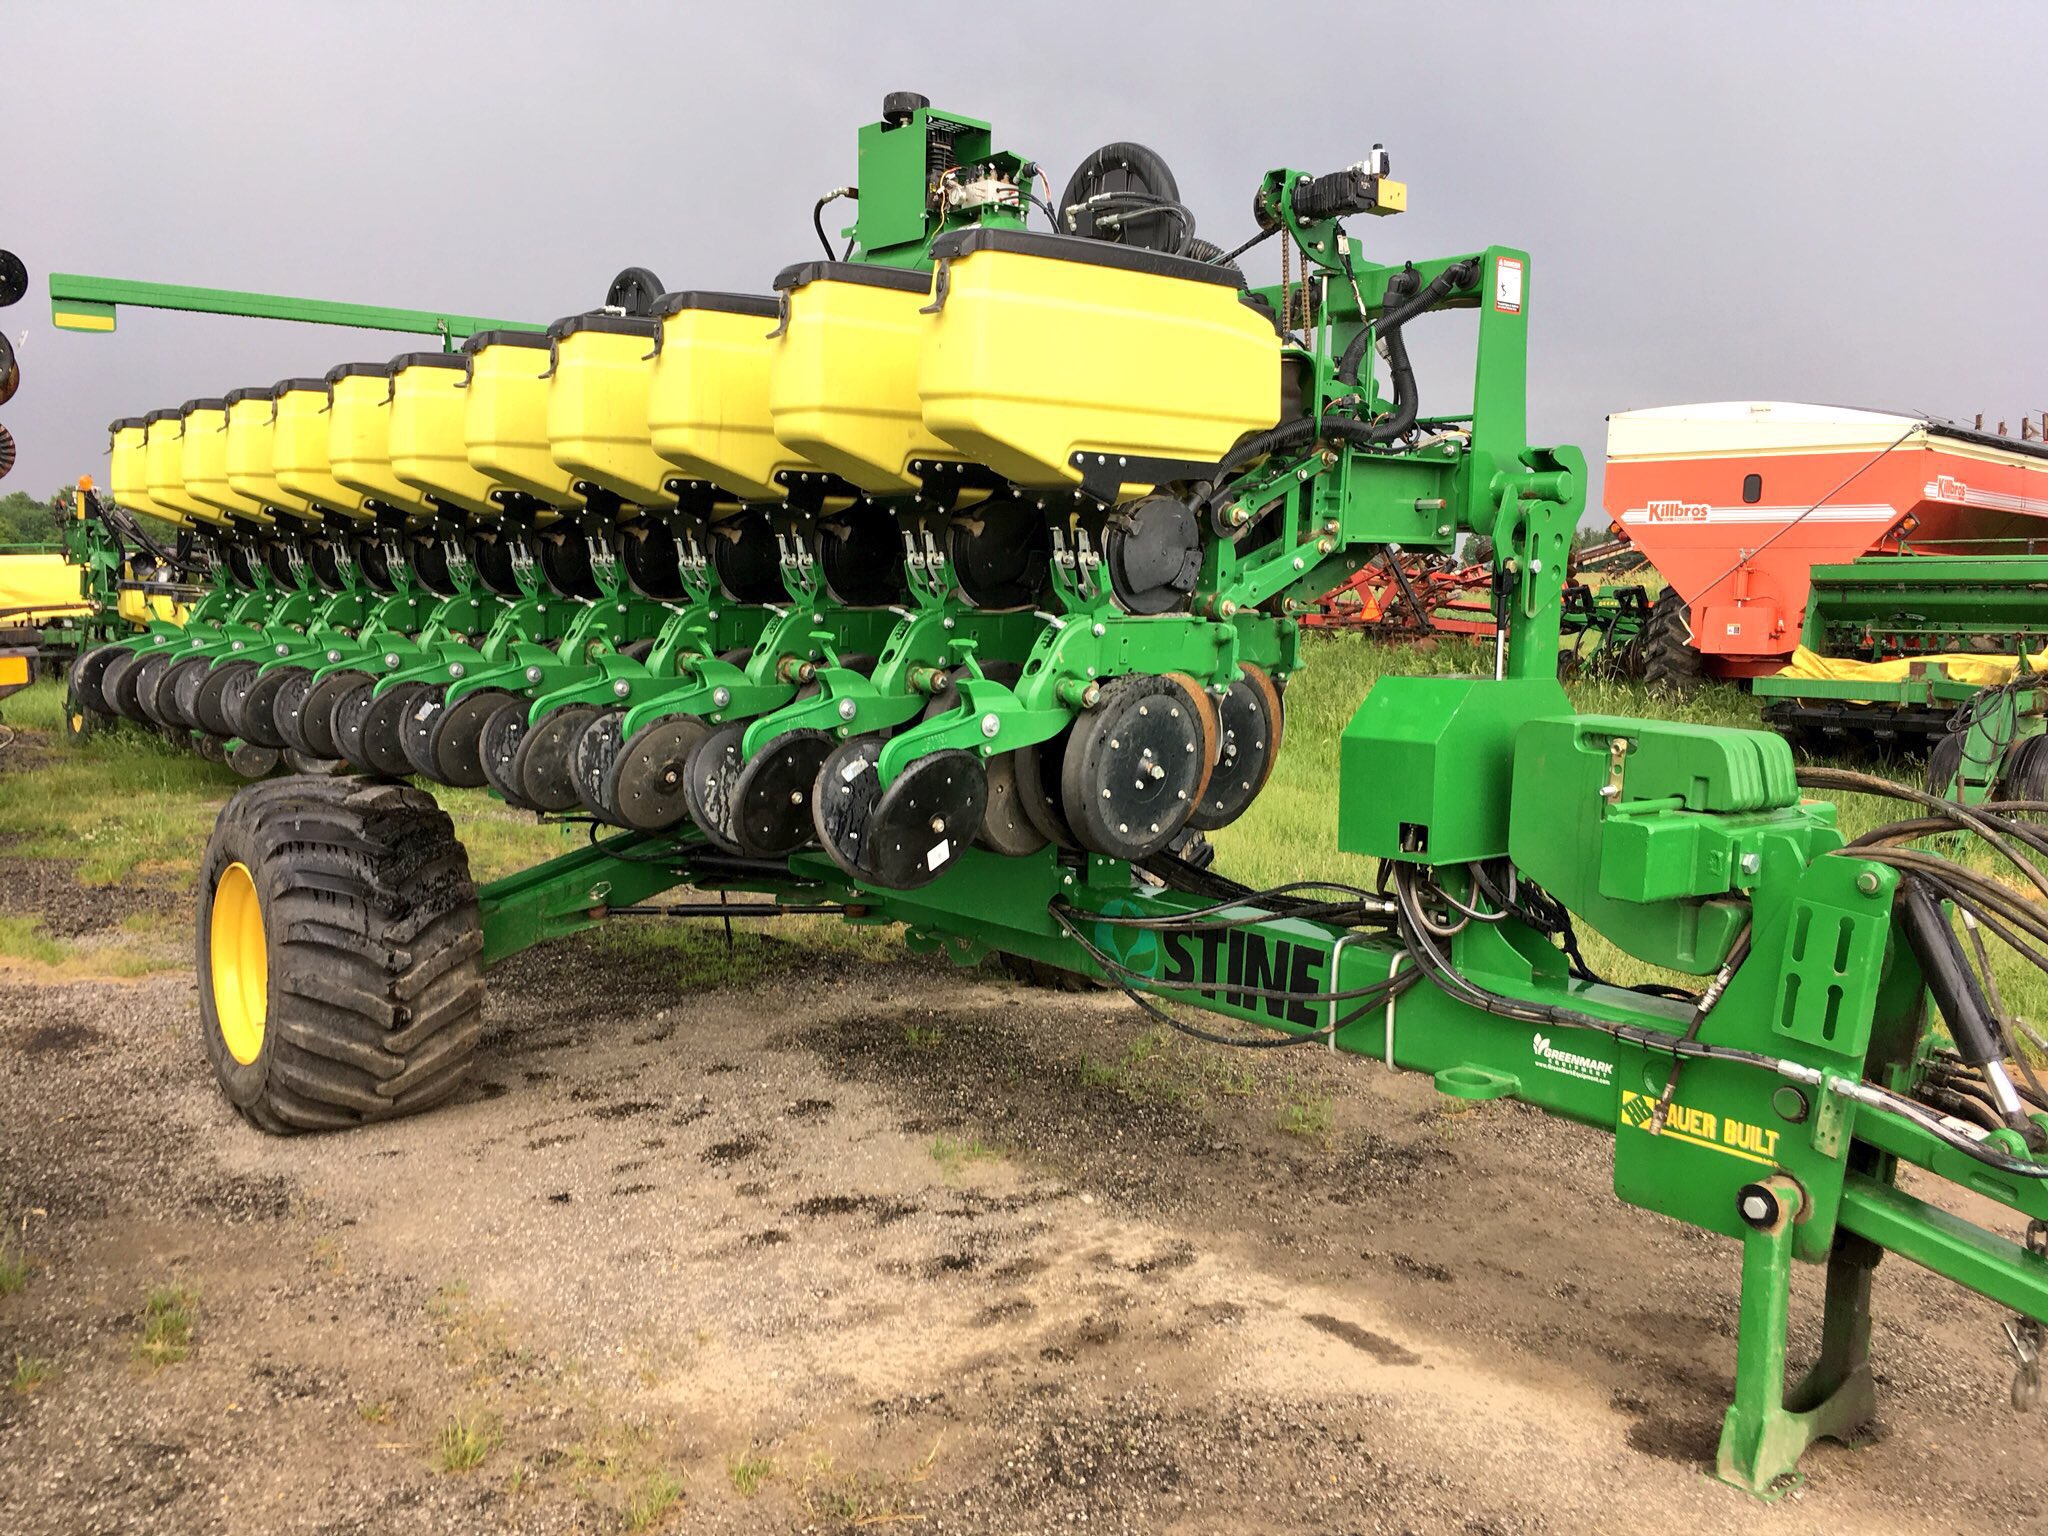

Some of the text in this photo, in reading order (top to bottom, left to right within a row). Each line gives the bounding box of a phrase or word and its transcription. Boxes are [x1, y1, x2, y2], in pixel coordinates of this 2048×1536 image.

[1648, 503, 1708, 522] Killbros
[1162, 926, 1327, 1030] STINE
[1543, 1047, 1614, 1074] GREENMARK
[1655, 1099, 1781, 1157] AUER BUILT
